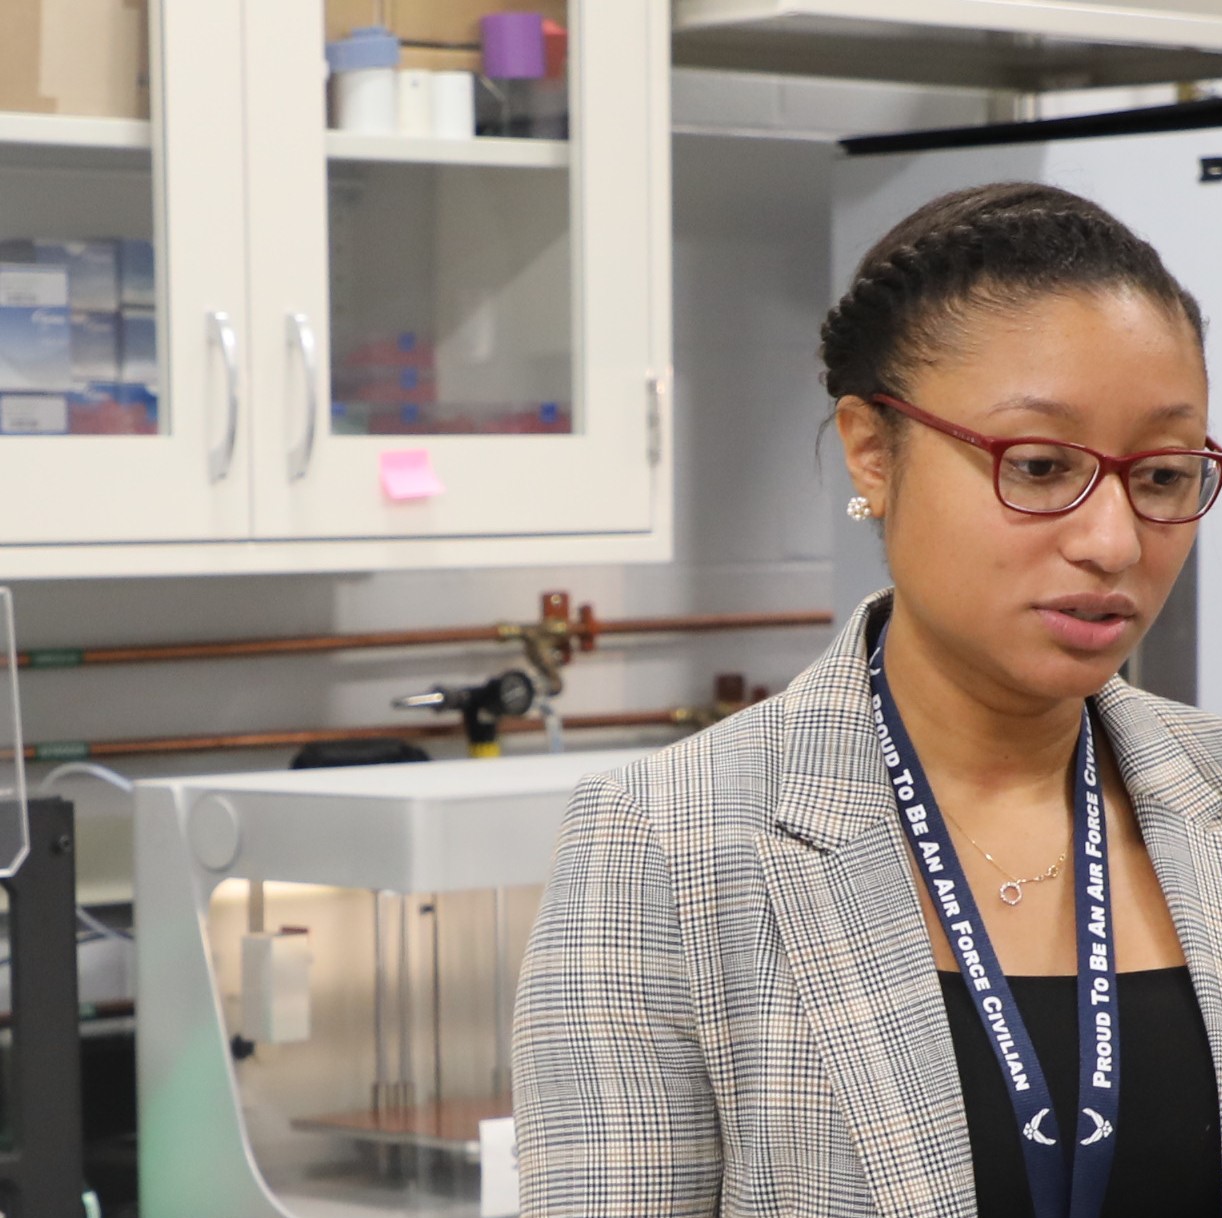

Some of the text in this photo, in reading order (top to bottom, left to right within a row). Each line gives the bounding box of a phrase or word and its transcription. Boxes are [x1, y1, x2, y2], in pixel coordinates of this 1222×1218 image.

[1085, 790, 1103, 859] FORCE
[872, 693, 1030, 1091] PROUD TO BE AN AIR FORCE CIVILIAN
[1086, 862, 1105, 902] AIR
[1087, 905, 1107, 939] AN
[1089, 942, 1108, 972] BE
[1090, 977, 1110, 1006] TO
[1092, 1011, 1112, 1089] PROUD
